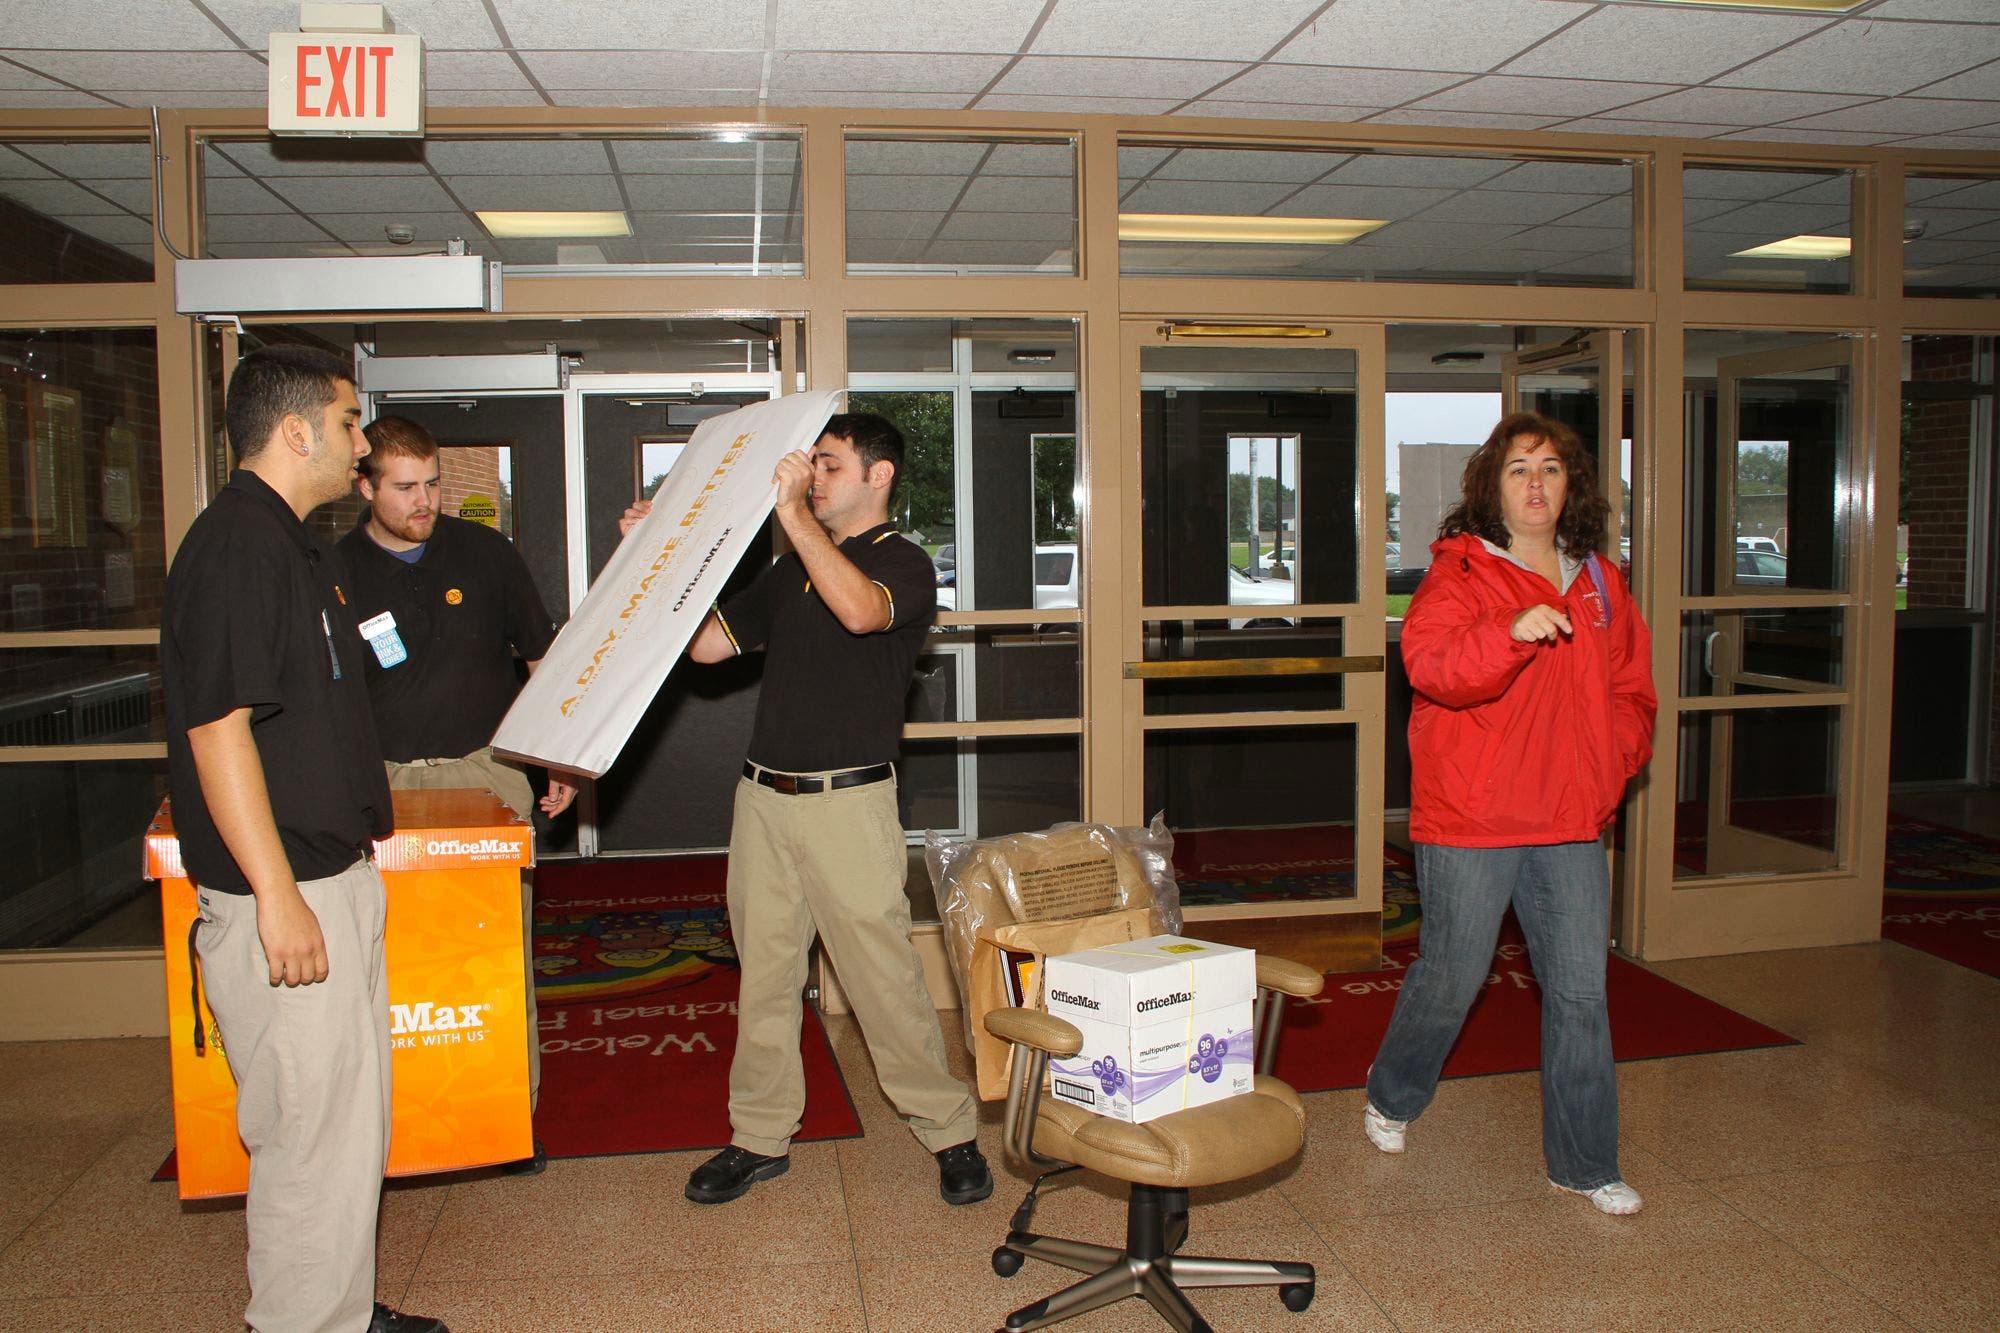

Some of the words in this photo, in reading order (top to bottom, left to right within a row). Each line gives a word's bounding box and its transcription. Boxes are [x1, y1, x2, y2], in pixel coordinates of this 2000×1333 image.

[296, 45, 394, 118] EXIT
[560, 696, 578, 717] A
[576, 629, 617, 685] DAY
[619, 536, 681, 619] MADE
[679, 432, 750, 527] BETTER
[673, 526, 733, 612] OfficeMax
[427, 839, 521, 856] OfficeMax
[536, 893, 727, 908] lementary
[1051, 989, 1100, 1010] OfficeMax
[1136, 991, 1193, 1013] OfficeMax
[390, 1002, 484, 1035] Max
[592, 1001, 739, 1026] ichael
[422, 1032, 461, 1047] WITH
[467, 1030, 485, 1042] US
[539, 1032, 716, 1056] Welco
[1200, 1039, 1211, 1051] 96
